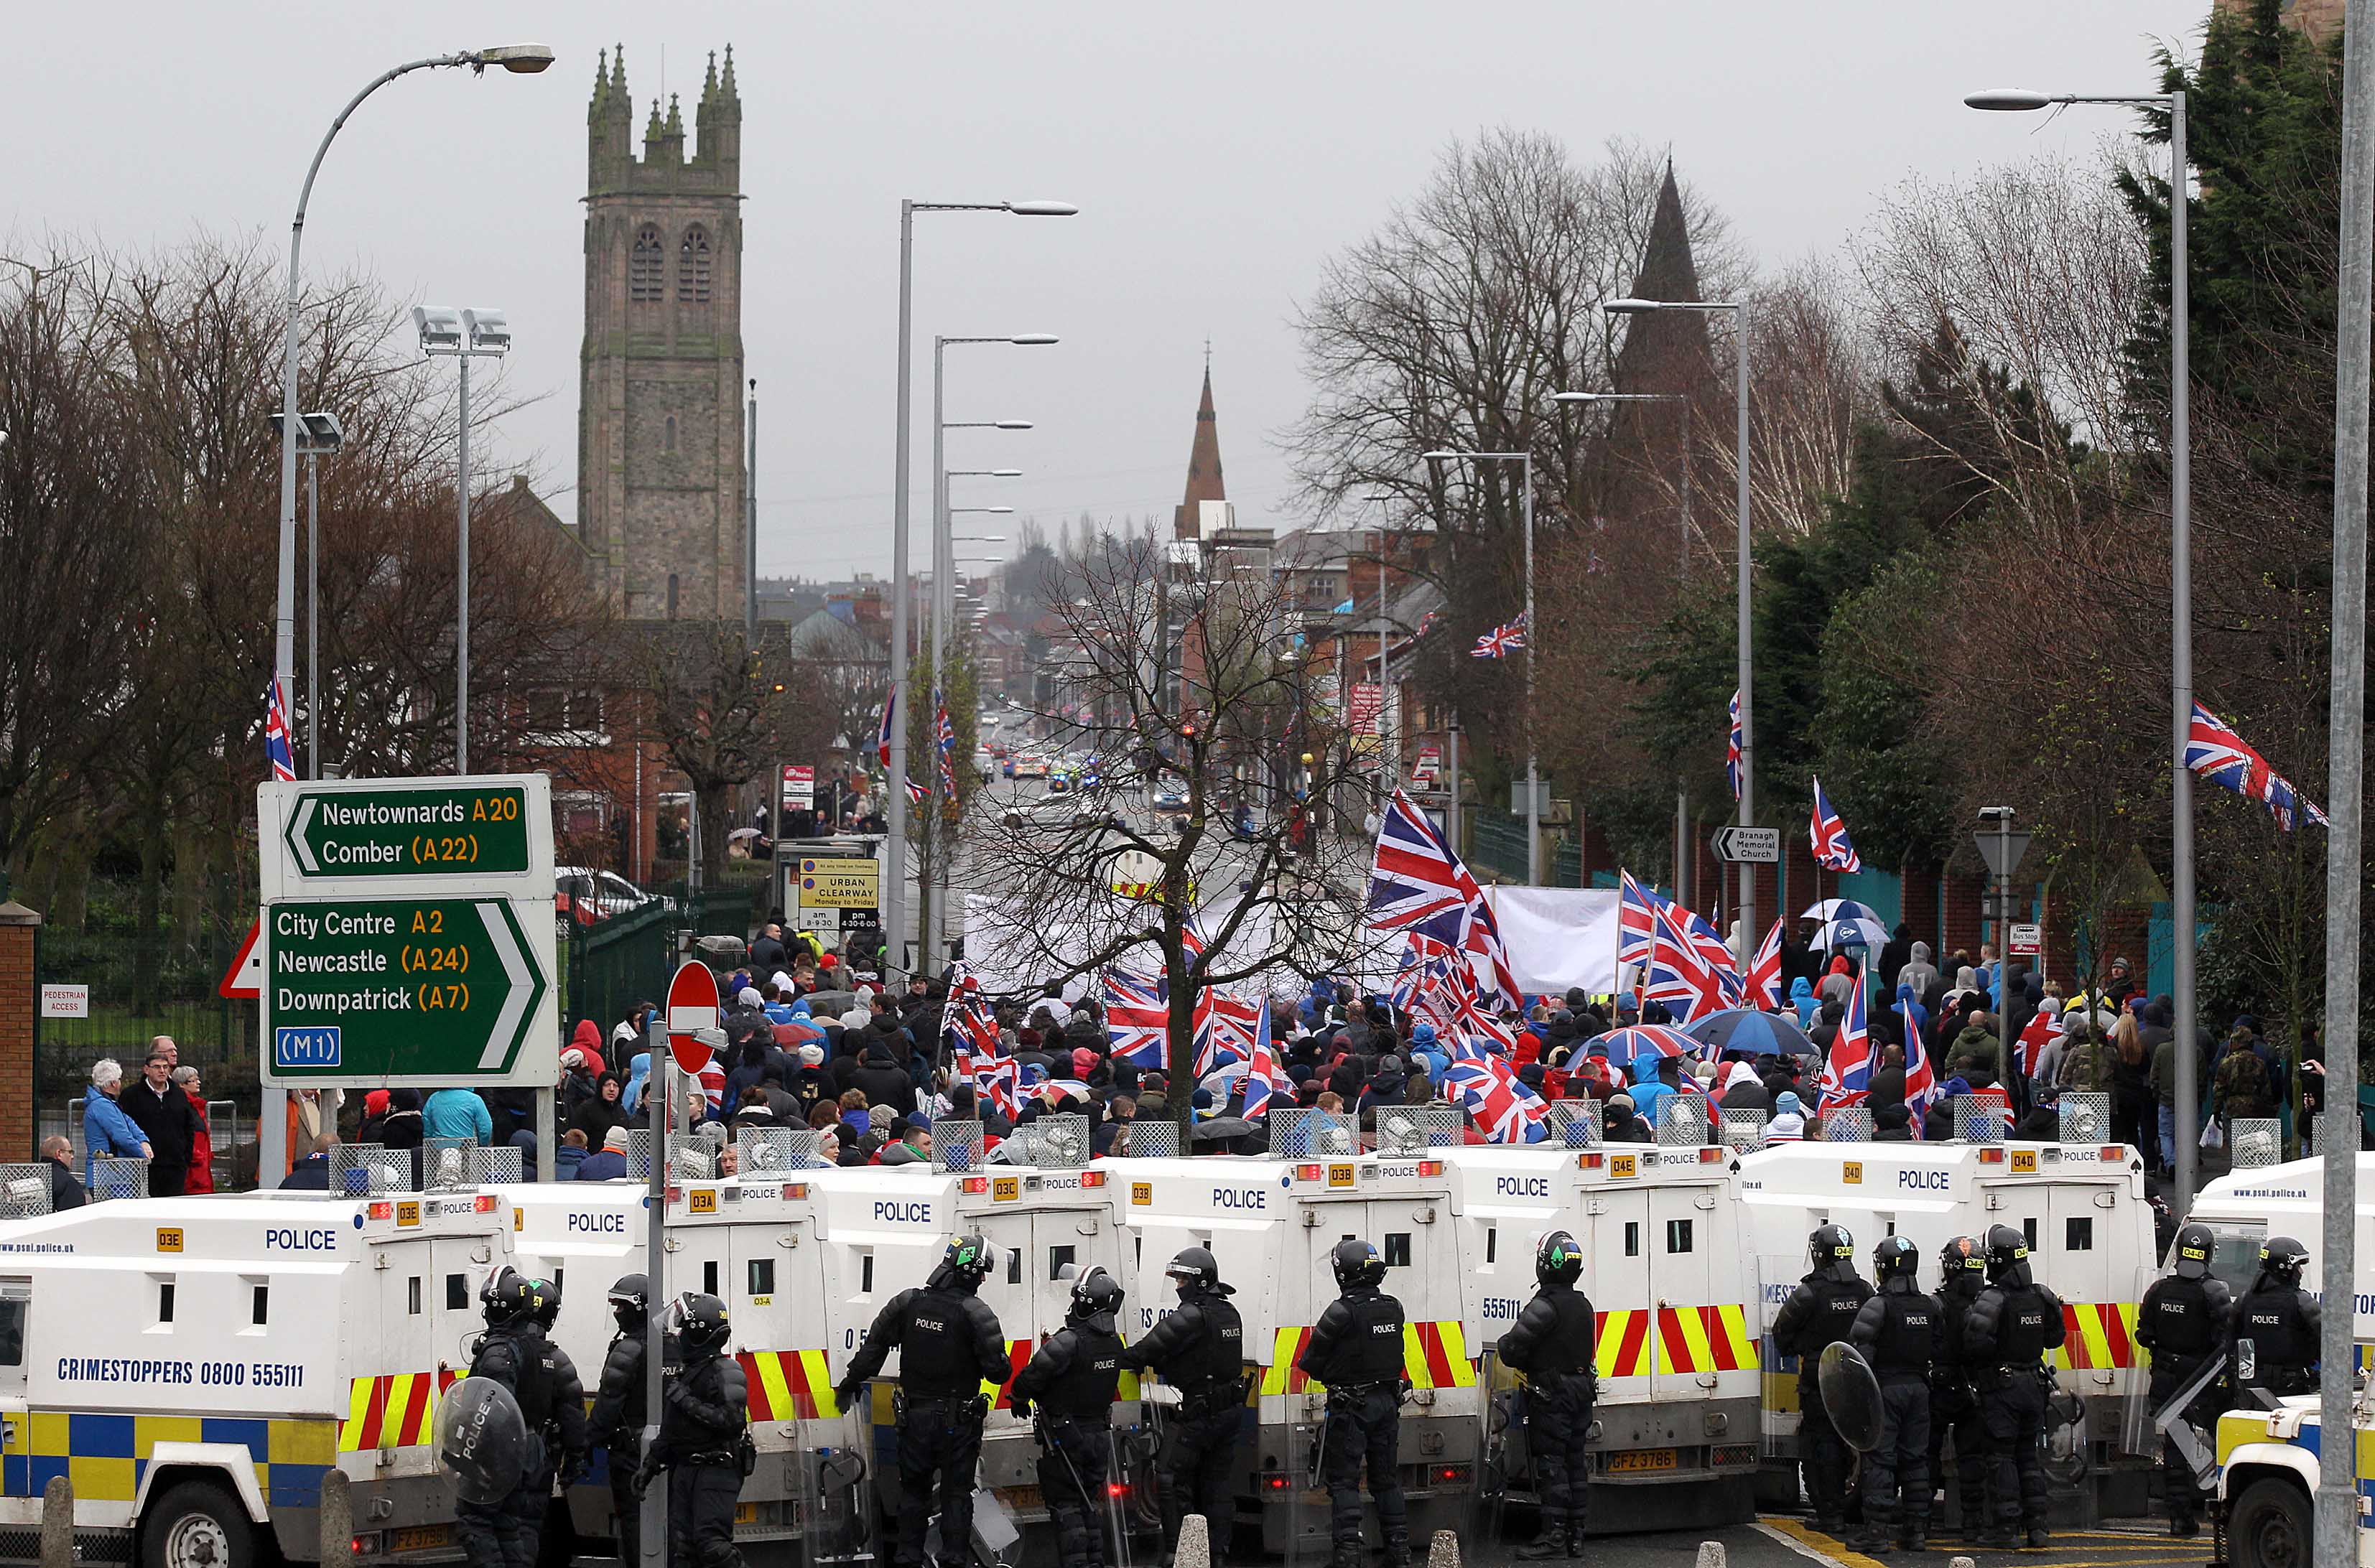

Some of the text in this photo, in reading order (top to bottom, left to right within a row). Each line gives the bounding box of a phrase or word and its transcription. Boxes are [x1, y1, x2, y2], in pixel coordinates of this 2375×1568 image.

[323, 799, 464, 826] Newtownards
[1739, 831, 1774, 840] Branagh
[323, 840, 403, 864] Comber
[276, 913, 318, 941] City
[325, 911, 396, 935] Centre
[278, 948, 386, 973] Newcastle
[279, 987, 412, 1015] Downpatrick
[1664, 1154, 1695, 1165] POLICE
[2065, 1152, 2095, 1161] POLICE
[1383, 1167, 1414, 1177] POLICE
[1046, 1179, 1077, 1189] POLICE
[1899, 1170, 1949, 1190] POLICE
[743, 1189, 776, 1198] POLICE
[1497, 1177, 1548, 1197] POLICE
[2234, 1189, 2307, 1198] www.psni.police.uk
[1213, 1189, 1265, 1209] POLICE
[444, 1203, 471, 1213] POLICE
[875, 1202, 931, 1222] POLICE
[569, 1213, 624, 1232] POLICE
[266, 1229, 335, 1250] POLICE
[1483, 1297, 1520, 1320] 555111
[1832, 1301, 1859, 1310] POLICE
[2160, 1302, 2185, 1313] POLICE
[916, 1317, 944, 1332] POLICE
[1907, 1316, 1928, 1325] POLICE
[2021, 1315, 2042, 1325] POLICE
[2252, 1315, 2279, 1325] POLICE
[1222, 1327, 1241, 1338] POLICE
[1373, 1324, 1396, 1333] POLICE
[1094, 1359, 1115, 1370] POLICE
[58, 1358, 304, 1387] CRIMESTOPPERS 0800 555111
[463, 1402, 491, 1460] POLICE
[1613, 1452, 1671, 1469] GFZ 3786
